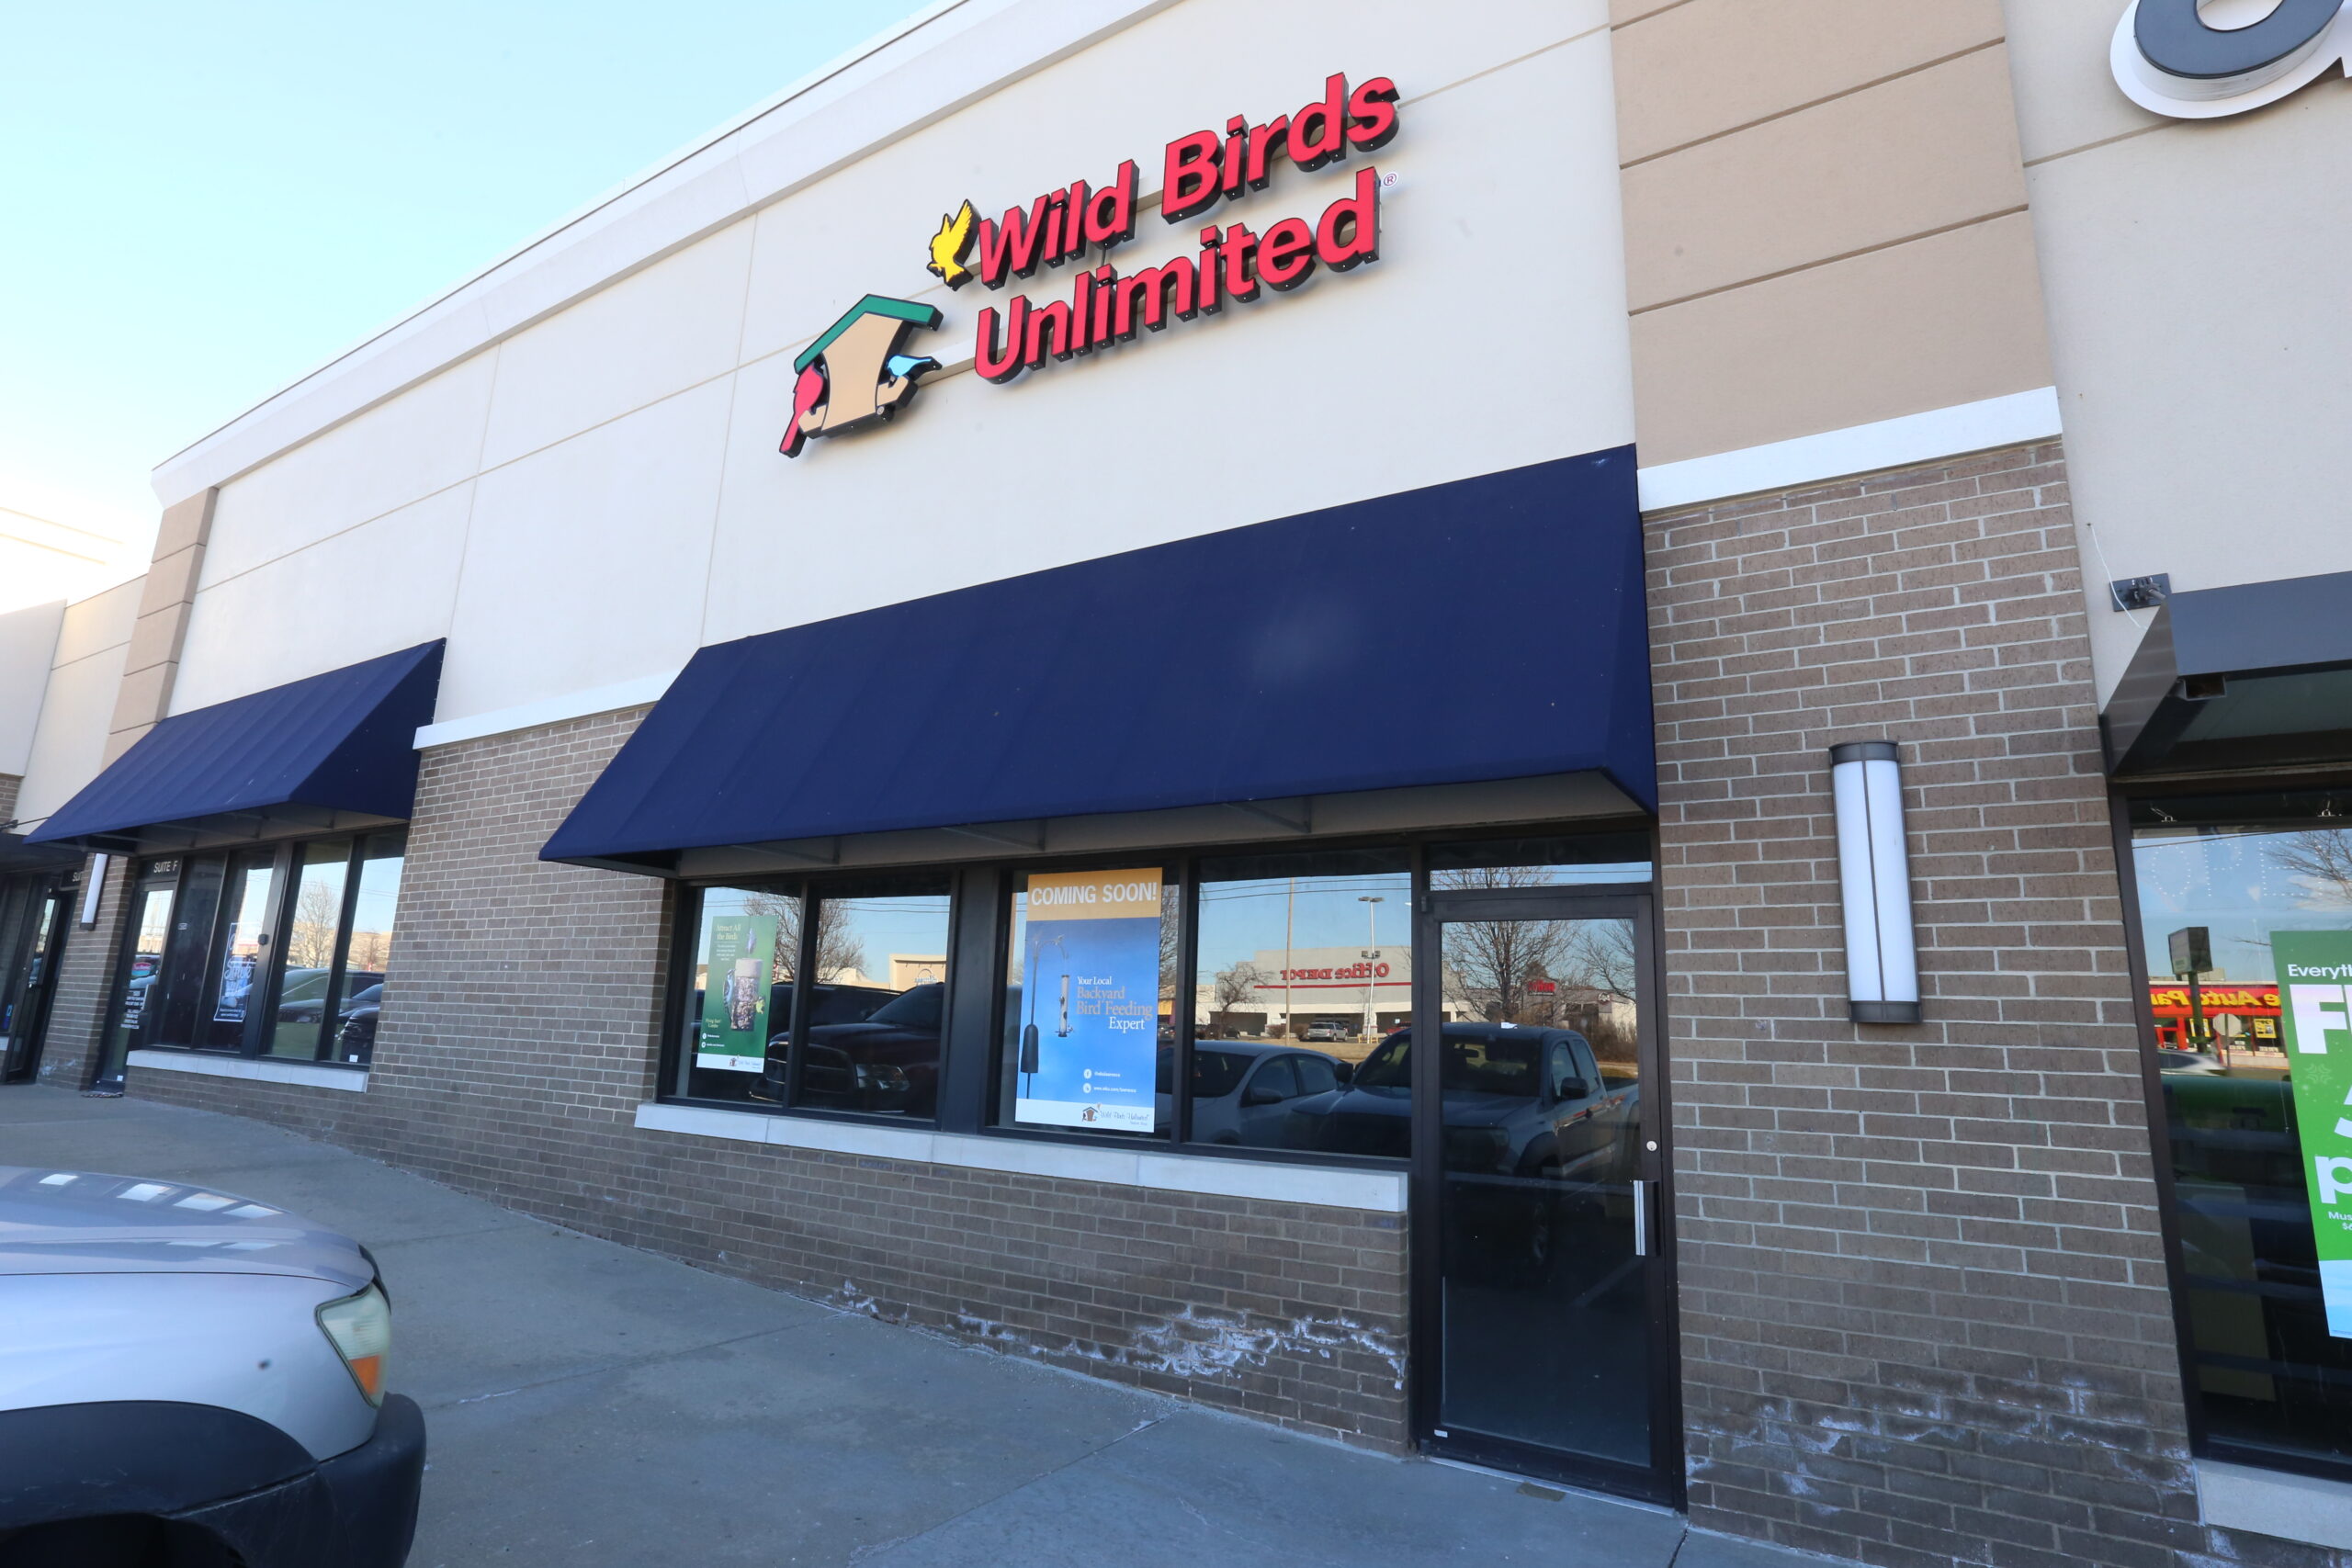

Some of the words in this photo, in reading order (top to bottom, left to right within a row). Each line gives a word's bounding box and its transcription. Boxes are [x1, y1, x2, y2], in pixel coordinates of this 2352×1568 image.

[978, 158, 1137, 288] Wild
[1161, 73, 1399, 220] Birds
[975, 166, 1378, 382] Unlimited
[153, 861, 171, 874] SUITE
[1031, 886, 1096, 906] COMING
[1102, 882, 1157, 903] SOON!
[1078, 976, 1092, 986] Your
[1093, 976, 1112, 986] Local
[2288, 964, 2352, 980] Everyt
[1077, 986, 1125, 999] Backyard
[1077, 1000, 1101, 1015] Bird
[1104, 1000, 1153, 1021] Feeding
[2290, 984, 2352, 1055] F
[1109, 1016, 1146, 1034] Expert
